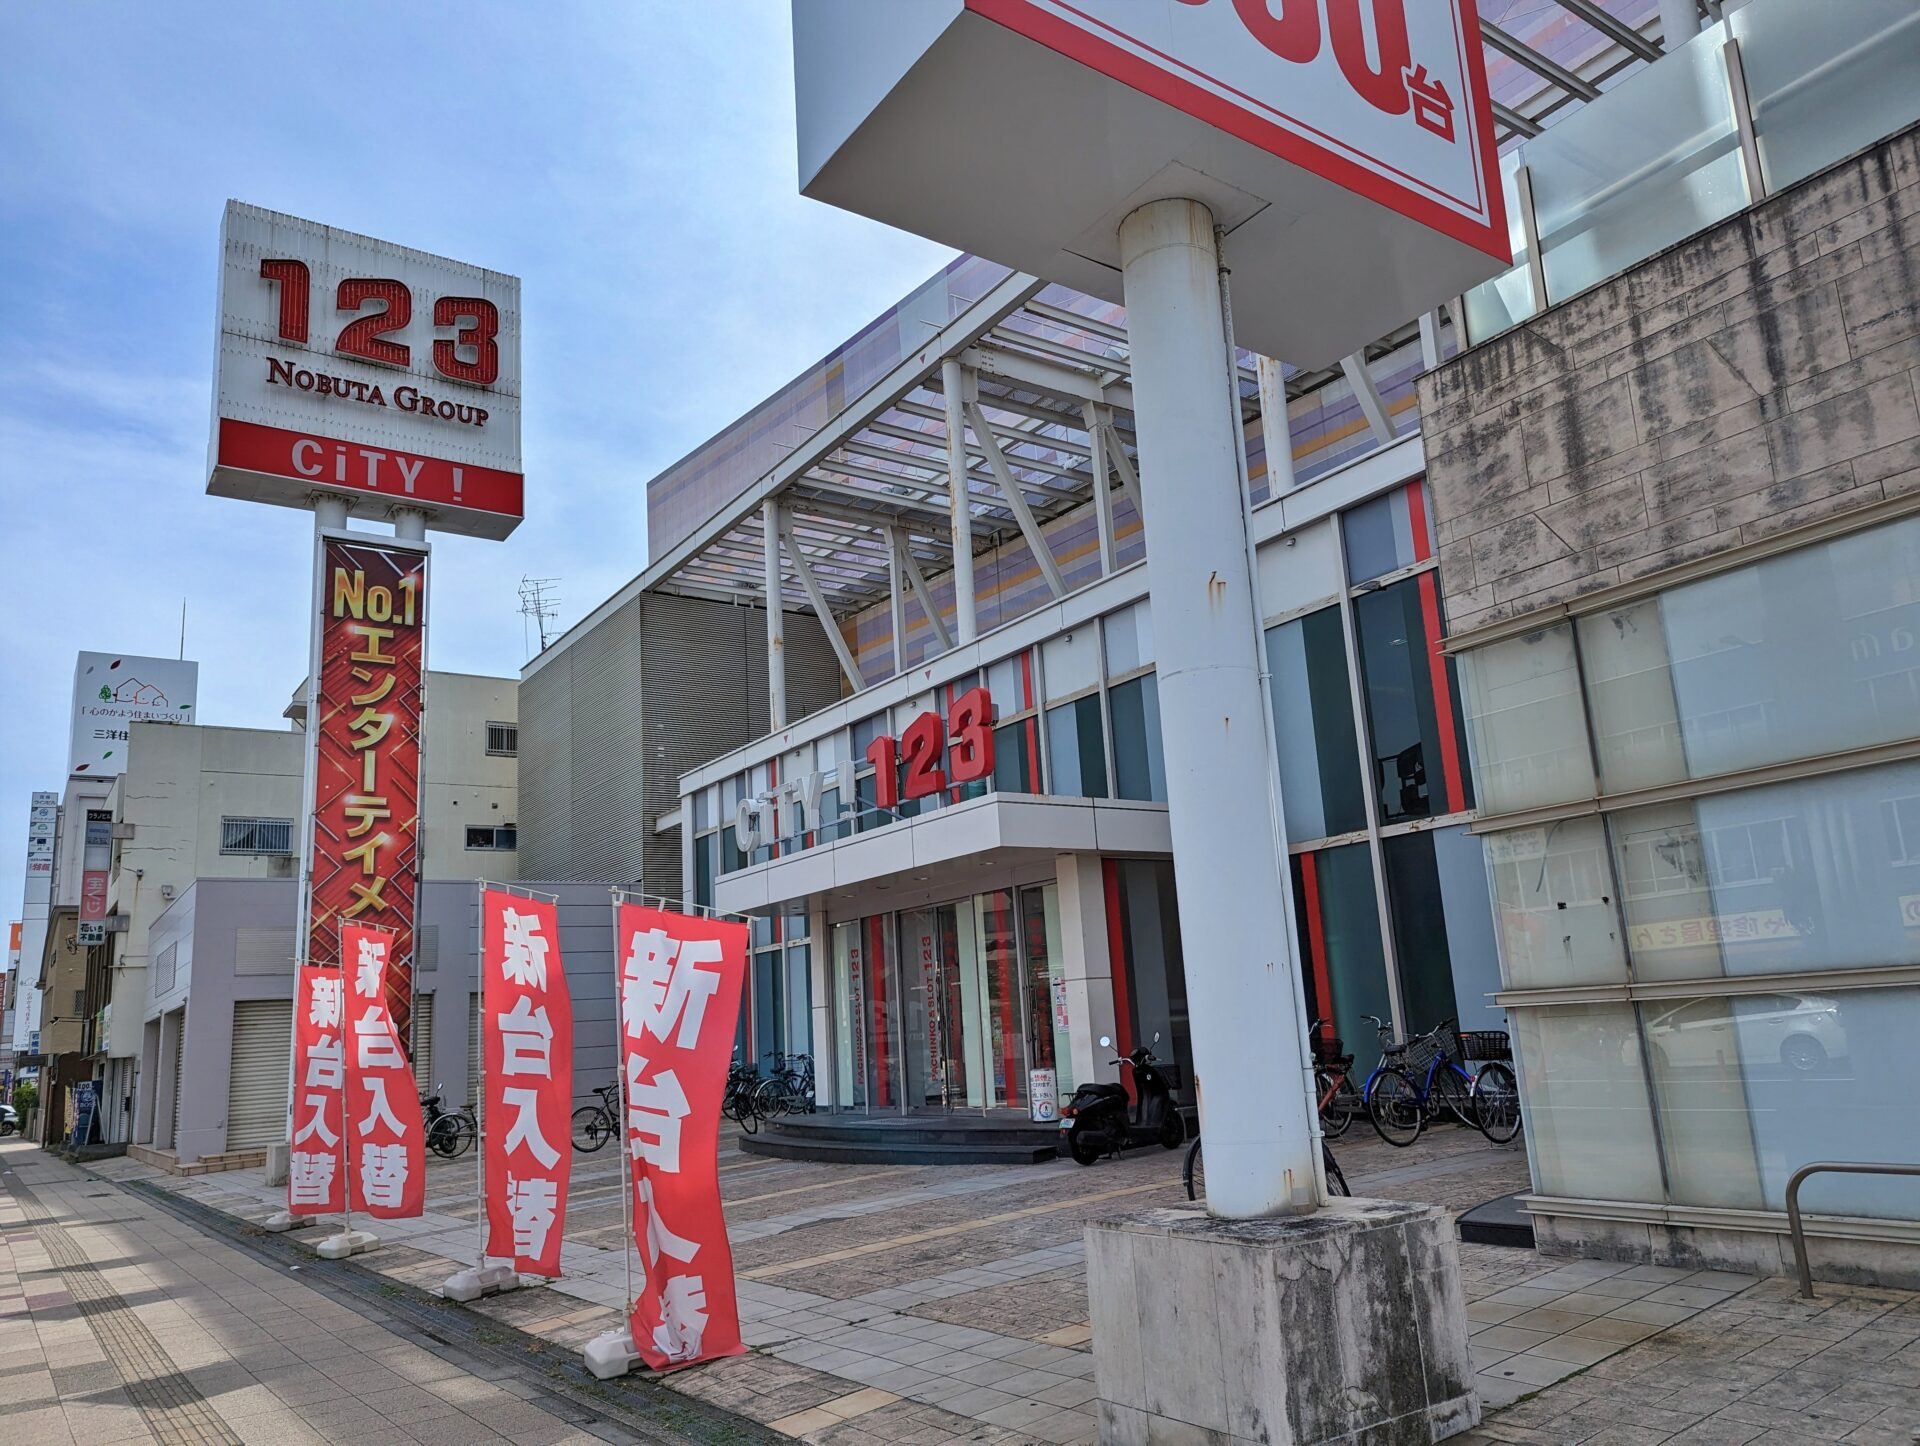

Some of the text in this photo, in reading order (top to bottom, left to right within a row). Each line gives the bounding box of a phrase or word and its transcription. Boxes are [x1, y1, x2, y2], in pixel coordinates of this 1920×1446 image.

[259, 258, 499, 386] 123
[333, 567, 416, 626] No.1
[342, 626, 396, 926] エンターテイメ
[866, 687, 996, 809] 123
[80, 923, 104, 933] 花いち
[80, 933, 103, 942] 不動産
[921, 935, 933, 973] 123
[850, 948, 861, 982] 123
[926, 976, 936, 1009] SLOT
[353, 937, 409, 1208] 新台入替
[927, 1018, 939, 1081] PACHINKO
[290, 976, 345, 1206] 新台入替
[497, 906, 562, 1262] 新台入替
